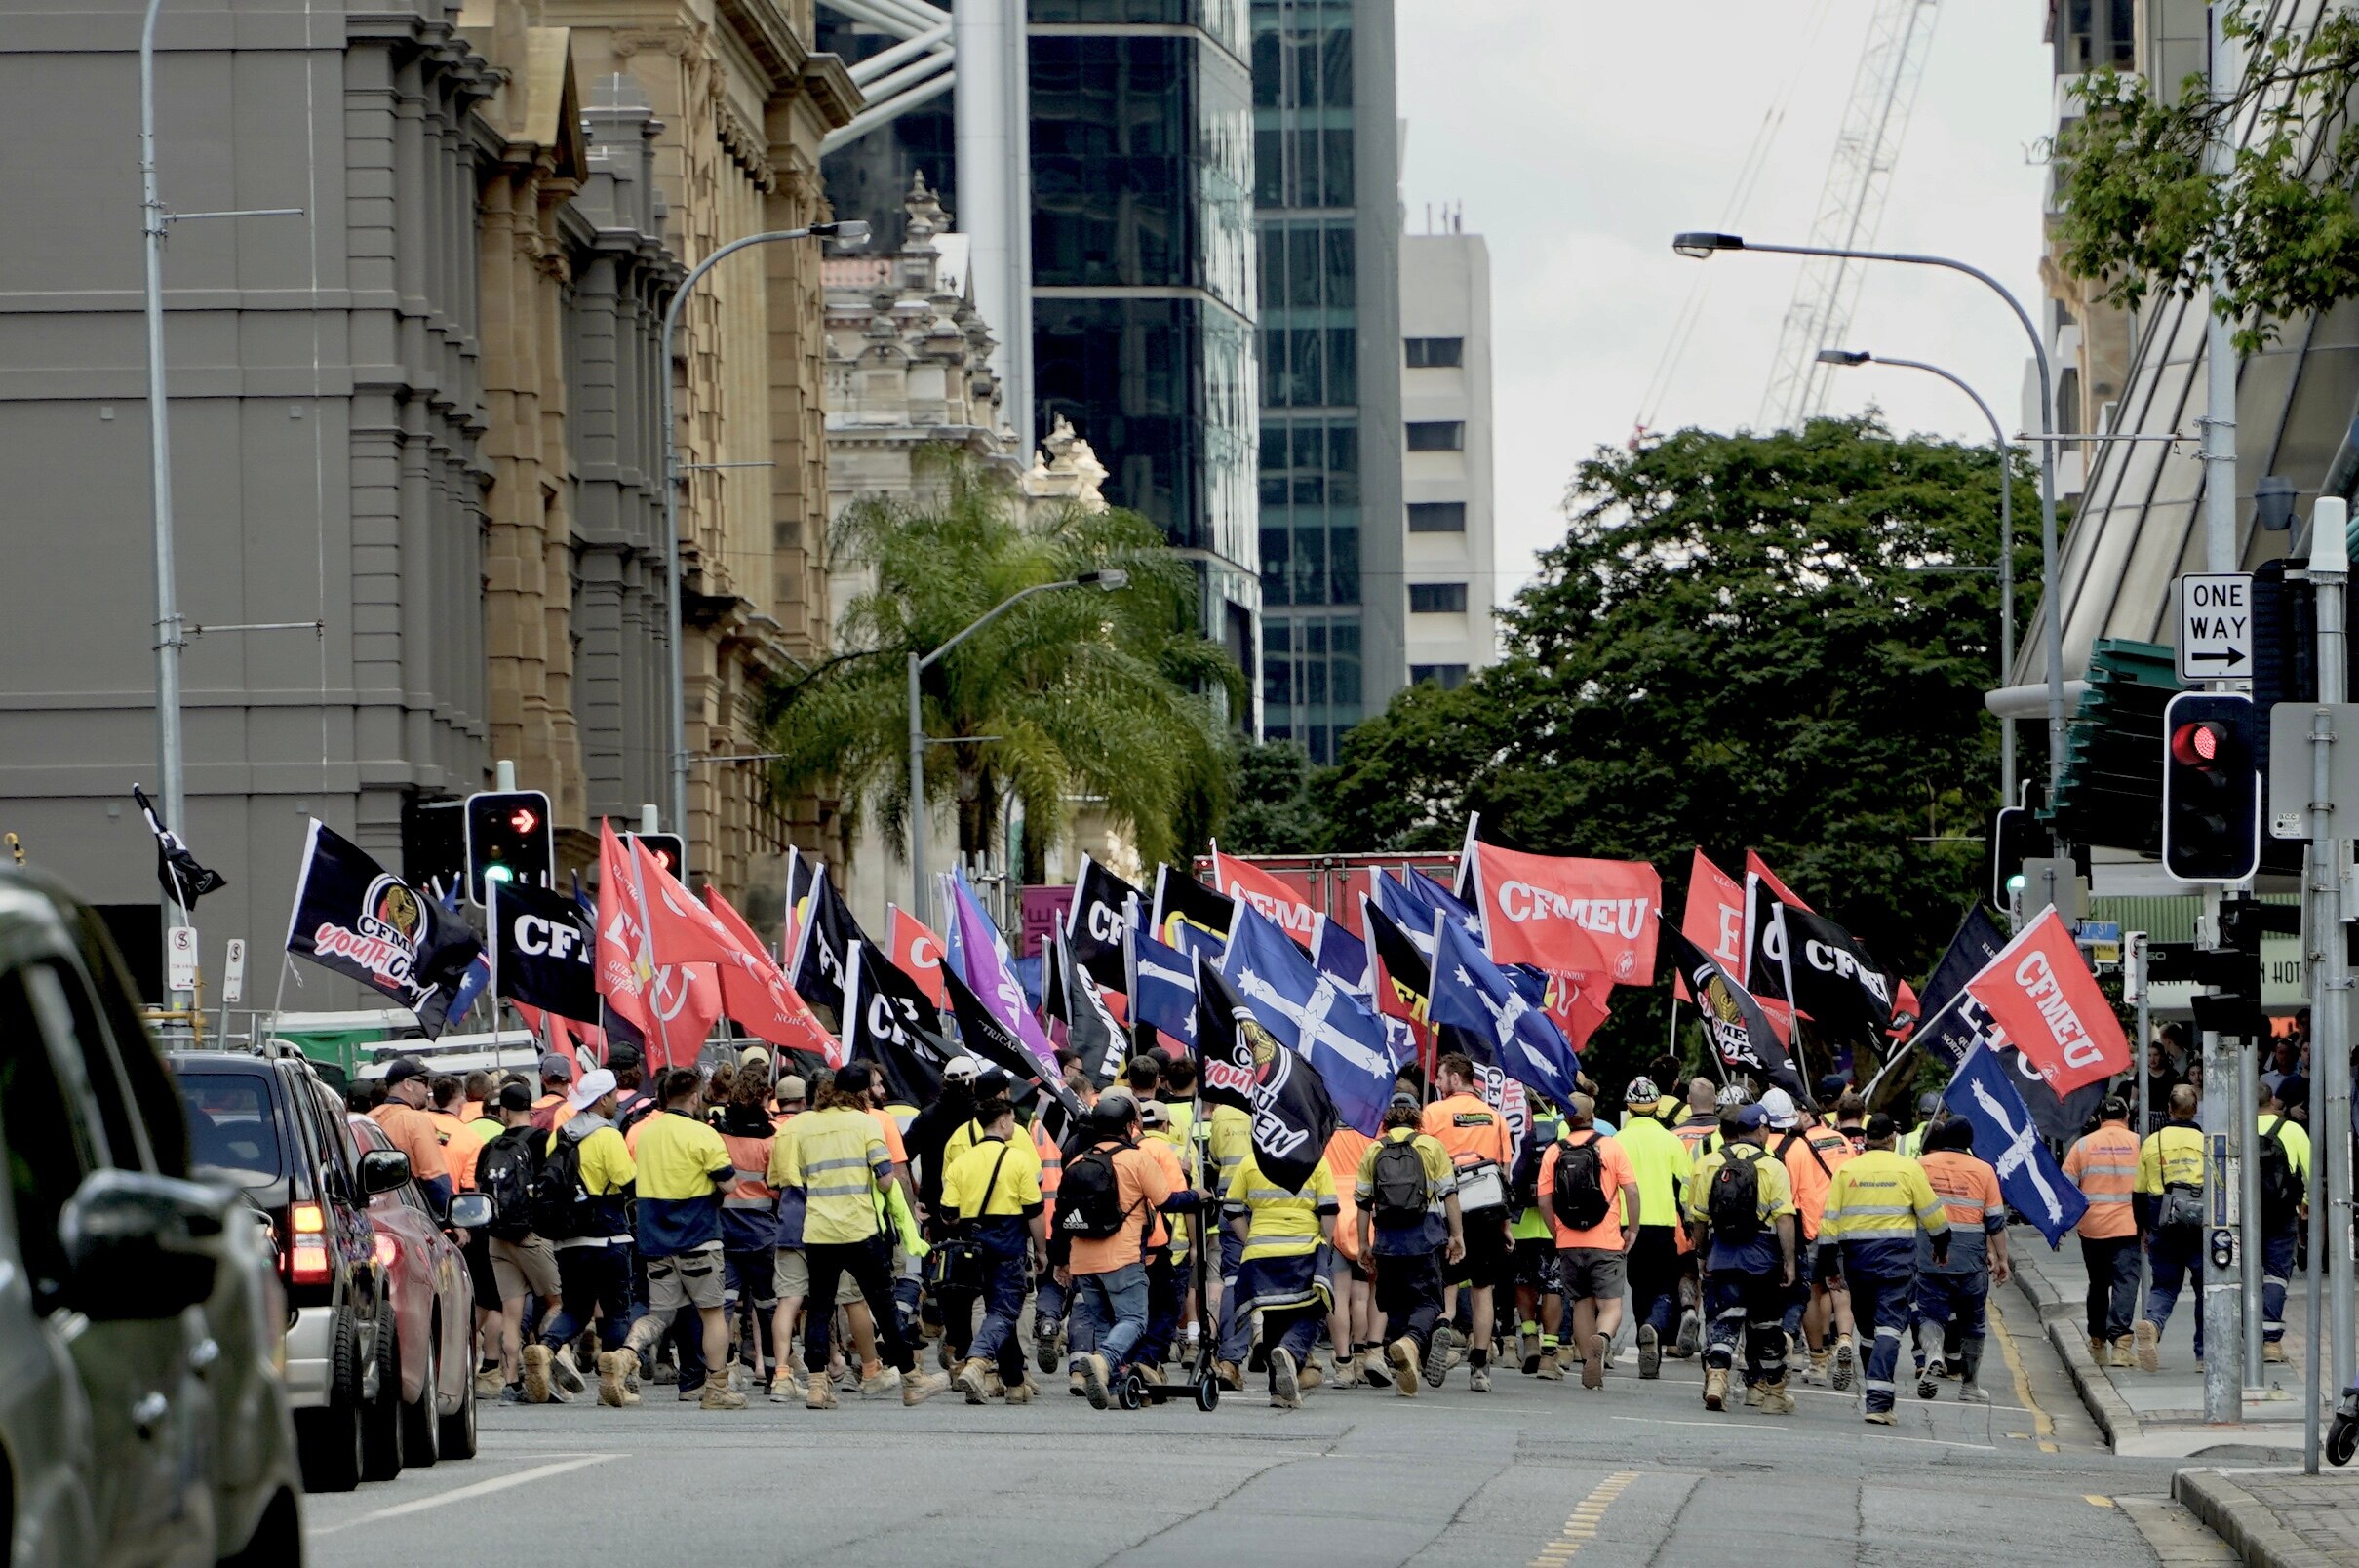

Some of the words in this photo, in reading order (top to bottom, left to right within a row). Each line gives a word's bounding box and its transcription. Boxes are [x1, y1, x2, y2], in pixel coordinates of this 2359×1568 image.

[2194, 585, 2243, 607] ONE
[2190, 617, 2247, 639] WAY
[1499, 880, 1649, 939] CFMEU
[2015, 950, 2104, 1069] CFMEU
